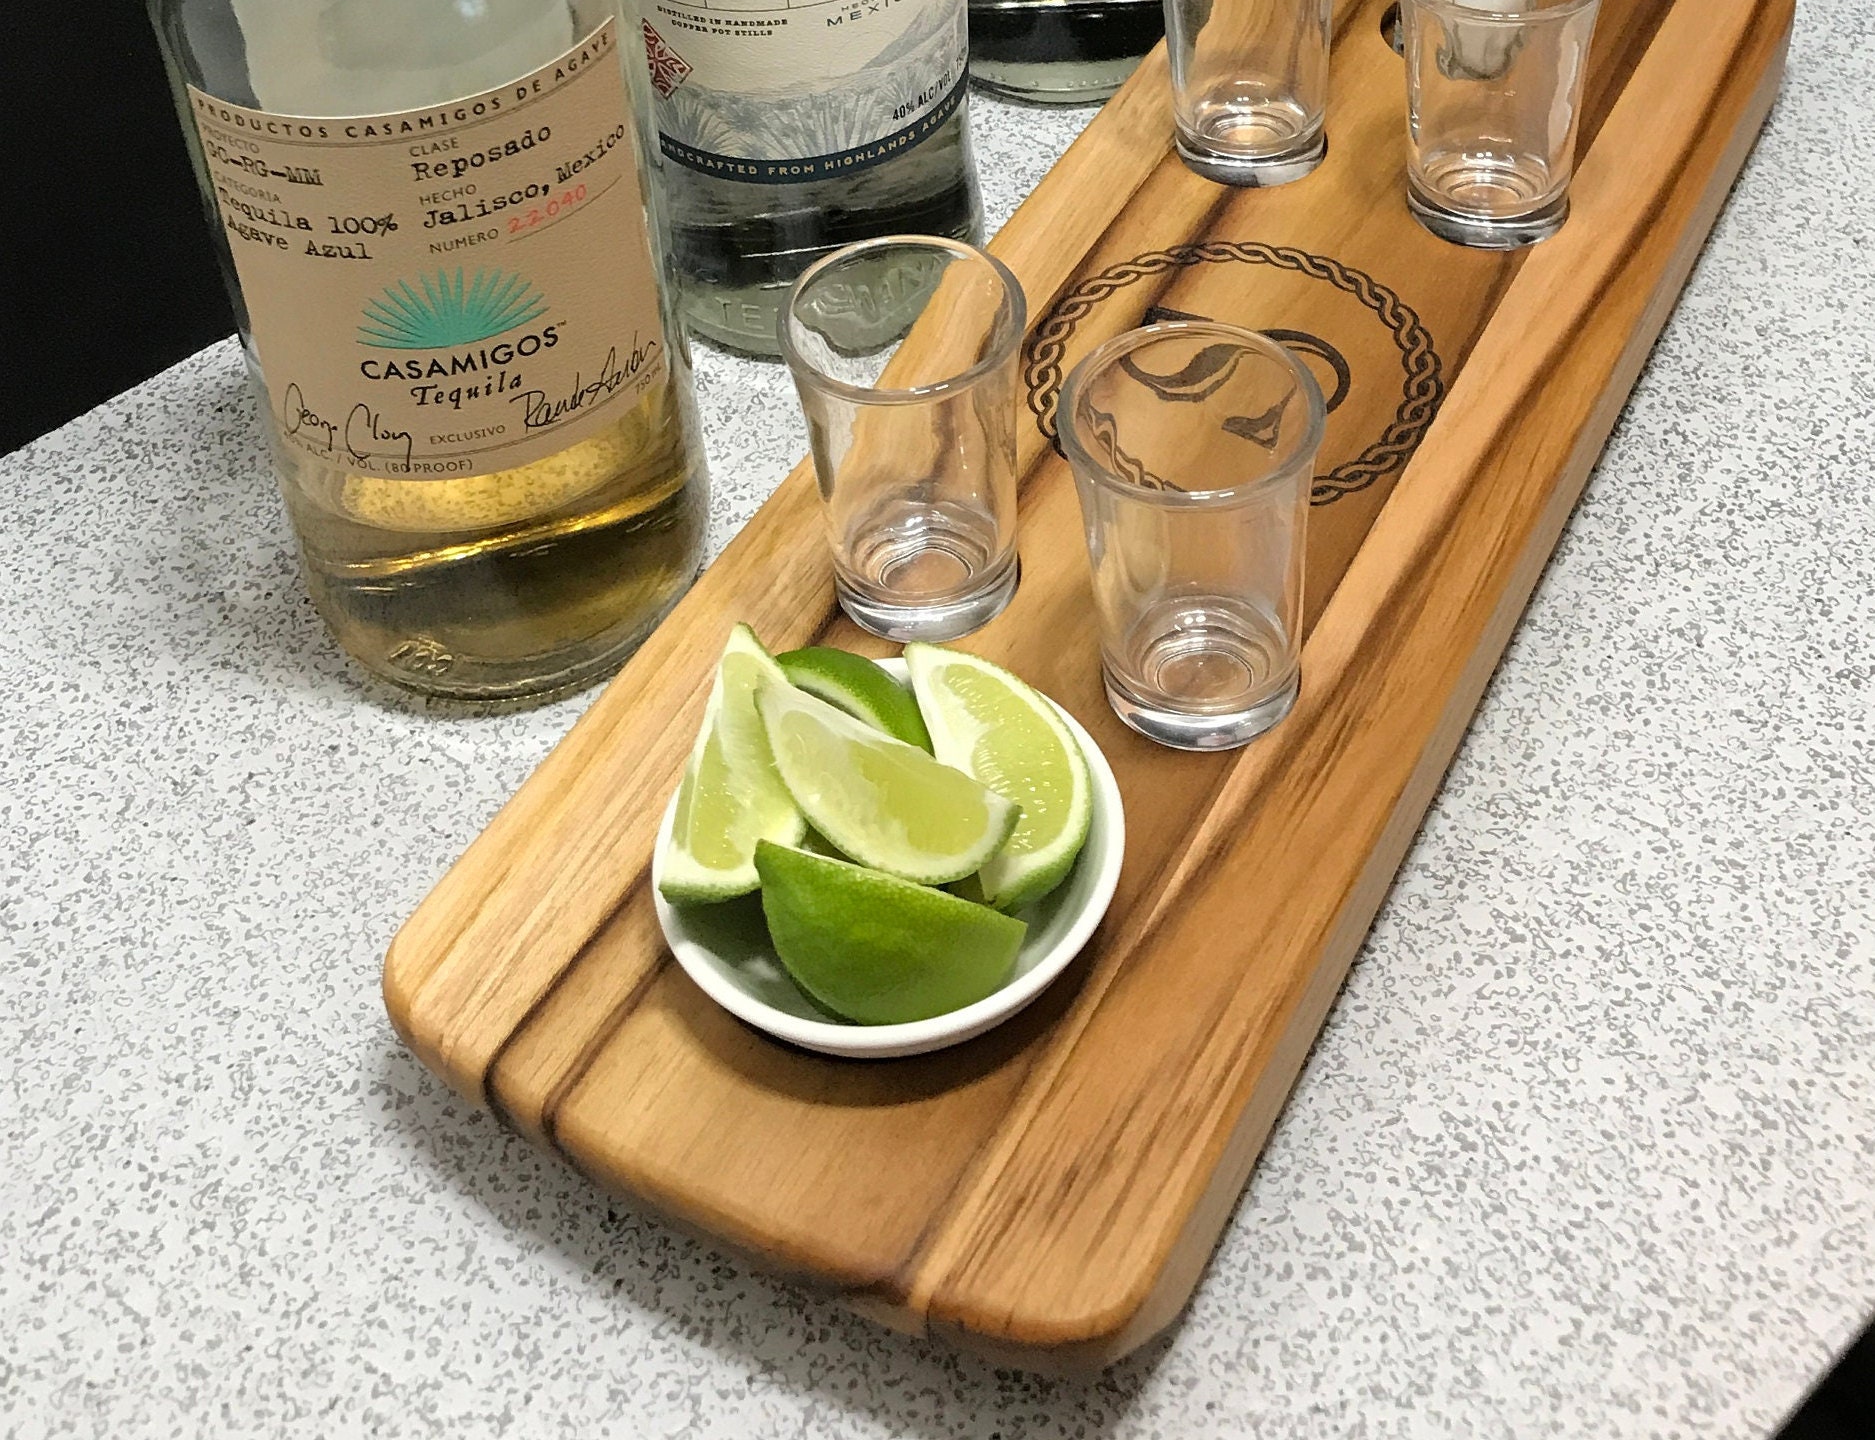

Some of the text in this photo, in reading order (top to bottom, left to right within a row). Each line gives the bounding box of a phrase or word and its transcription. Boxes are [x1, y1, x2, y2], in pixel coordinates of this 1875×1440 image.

[656, 5, 789, 28] DISTILLED IN HANDMADE
[671, 19, 773, 37] COPPER POT STILLS
[197, 32, 609, 139] PRODUCTOS CASAMIGOS DE AGAVE
[892, 101, 915, 121] 40%
[409, 136, 460, 158] CLASE
[767, 163, 815, 177] FROM
[824, 131, 916, 171] HIGHLANDS
[922, 95, 957, 133] AGAVE
[411, 126, 552, 182] Reposado
[422, 123, 626, 229] Jalisco, Mexico
[218, 185, 400, 237] Tequila 100%
[419, 183, 478, 206] HECHO
[226, 214, 375, 260] Agave Azul
[429, 227, 500, 254] NUMERO
[360, 325, 560, 381] CASAMIGOS
[410, 370, 523, 410] Tequila
[429, 423, 507, 446] EXCLUSIVO
[414, 458, 474, 474] PROOF)
